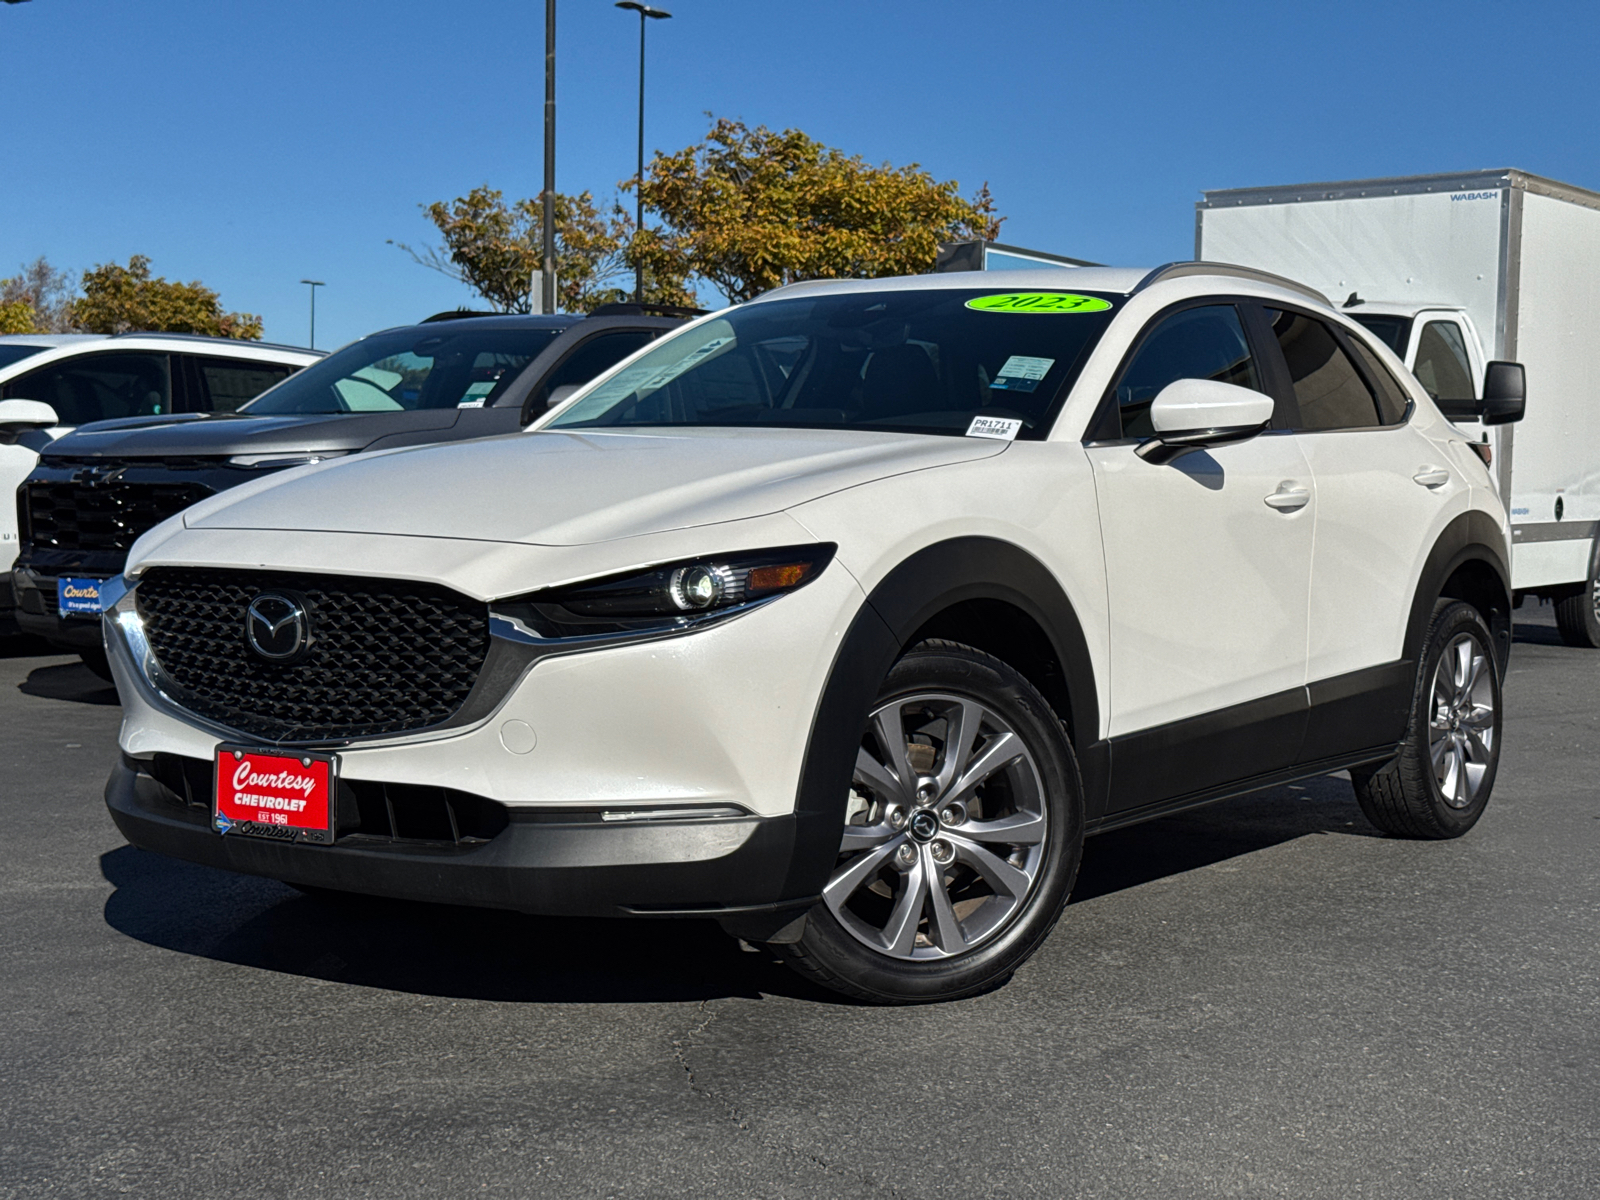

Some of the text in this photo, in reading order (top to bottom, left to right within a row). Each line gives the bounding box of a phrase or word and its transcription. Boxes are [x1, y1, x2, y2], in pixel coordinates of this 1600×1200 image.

[1450, 191, 1498, 202] WABASH
[984, 296, 1091, 309] 2023
[974, 419, 1013, 430] PR1711
[64, 585, 99, 598] Courte
[233, 761, 316, 798] Courtesy
[234, 792, 307, 812] CHEVROLET
[271, 813, 288, 824] 1961
[241, 820, 300, 844] Courtesy
